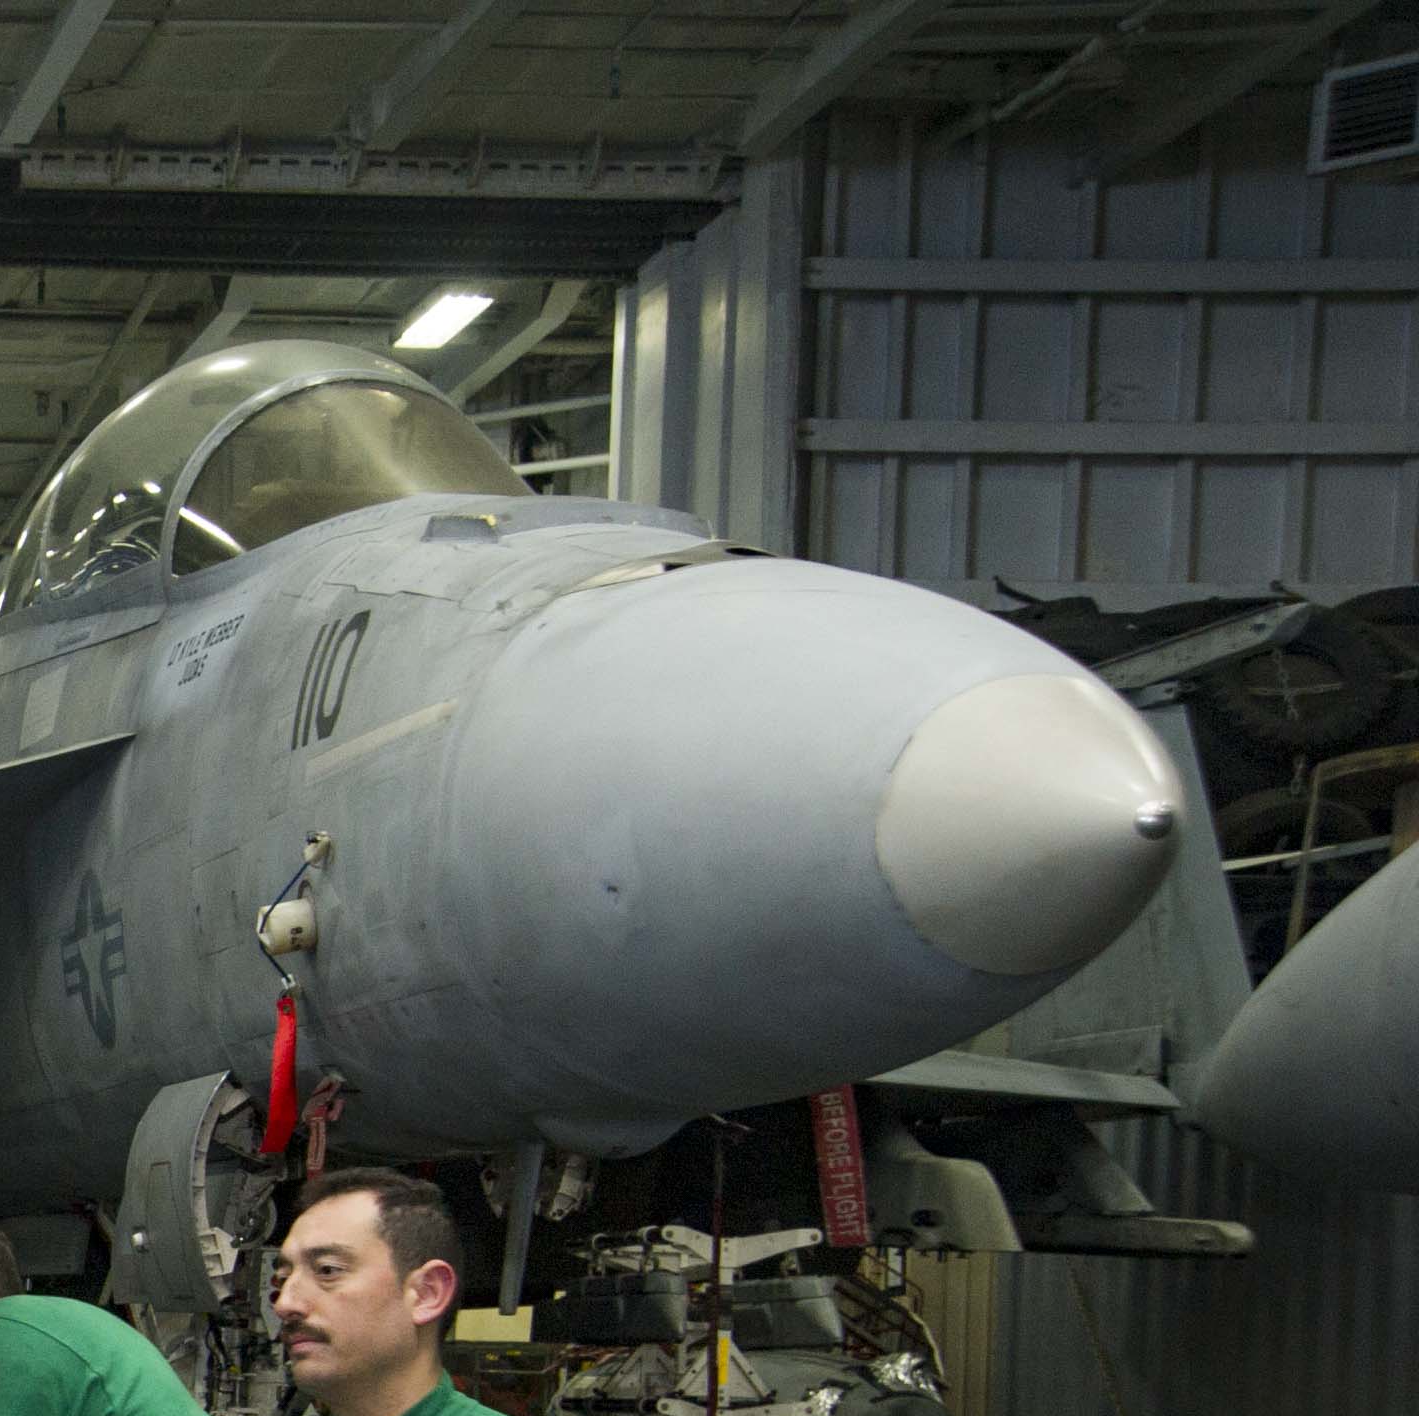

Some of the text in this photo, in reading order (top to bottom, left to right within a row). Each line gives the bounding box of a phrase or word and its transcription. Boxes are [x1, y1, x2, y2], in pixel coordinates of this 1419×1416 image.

[290, 609, 371, 751] 110
[818, 1091, 861, 1236] BEFORE FLIGHT
